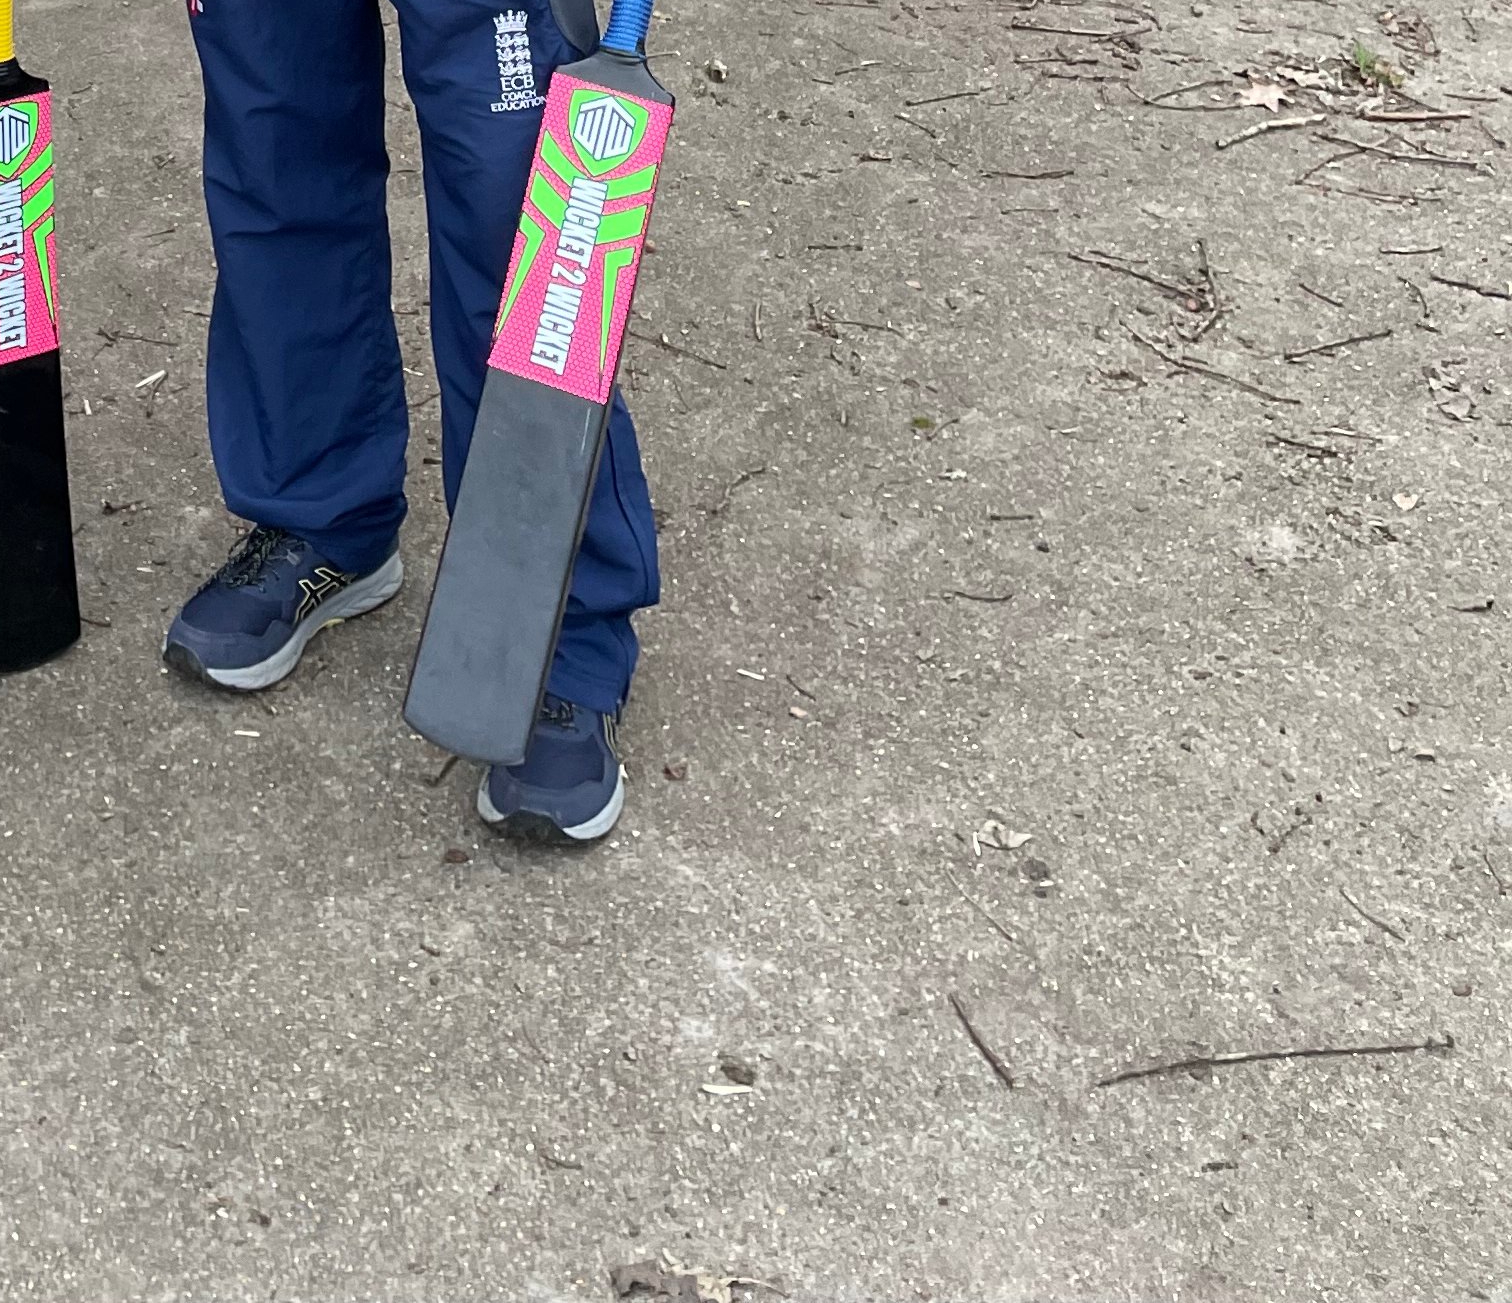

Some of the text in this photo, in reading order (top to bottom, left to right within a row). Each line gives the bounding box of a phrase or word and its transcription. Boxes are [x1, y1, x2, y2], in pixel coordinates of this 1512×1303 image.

[500, 74, 535, 91] ECB
[501, 88, 537, 102] COACH
[530, 176, 608, 376] WICKET 2 WICKET
